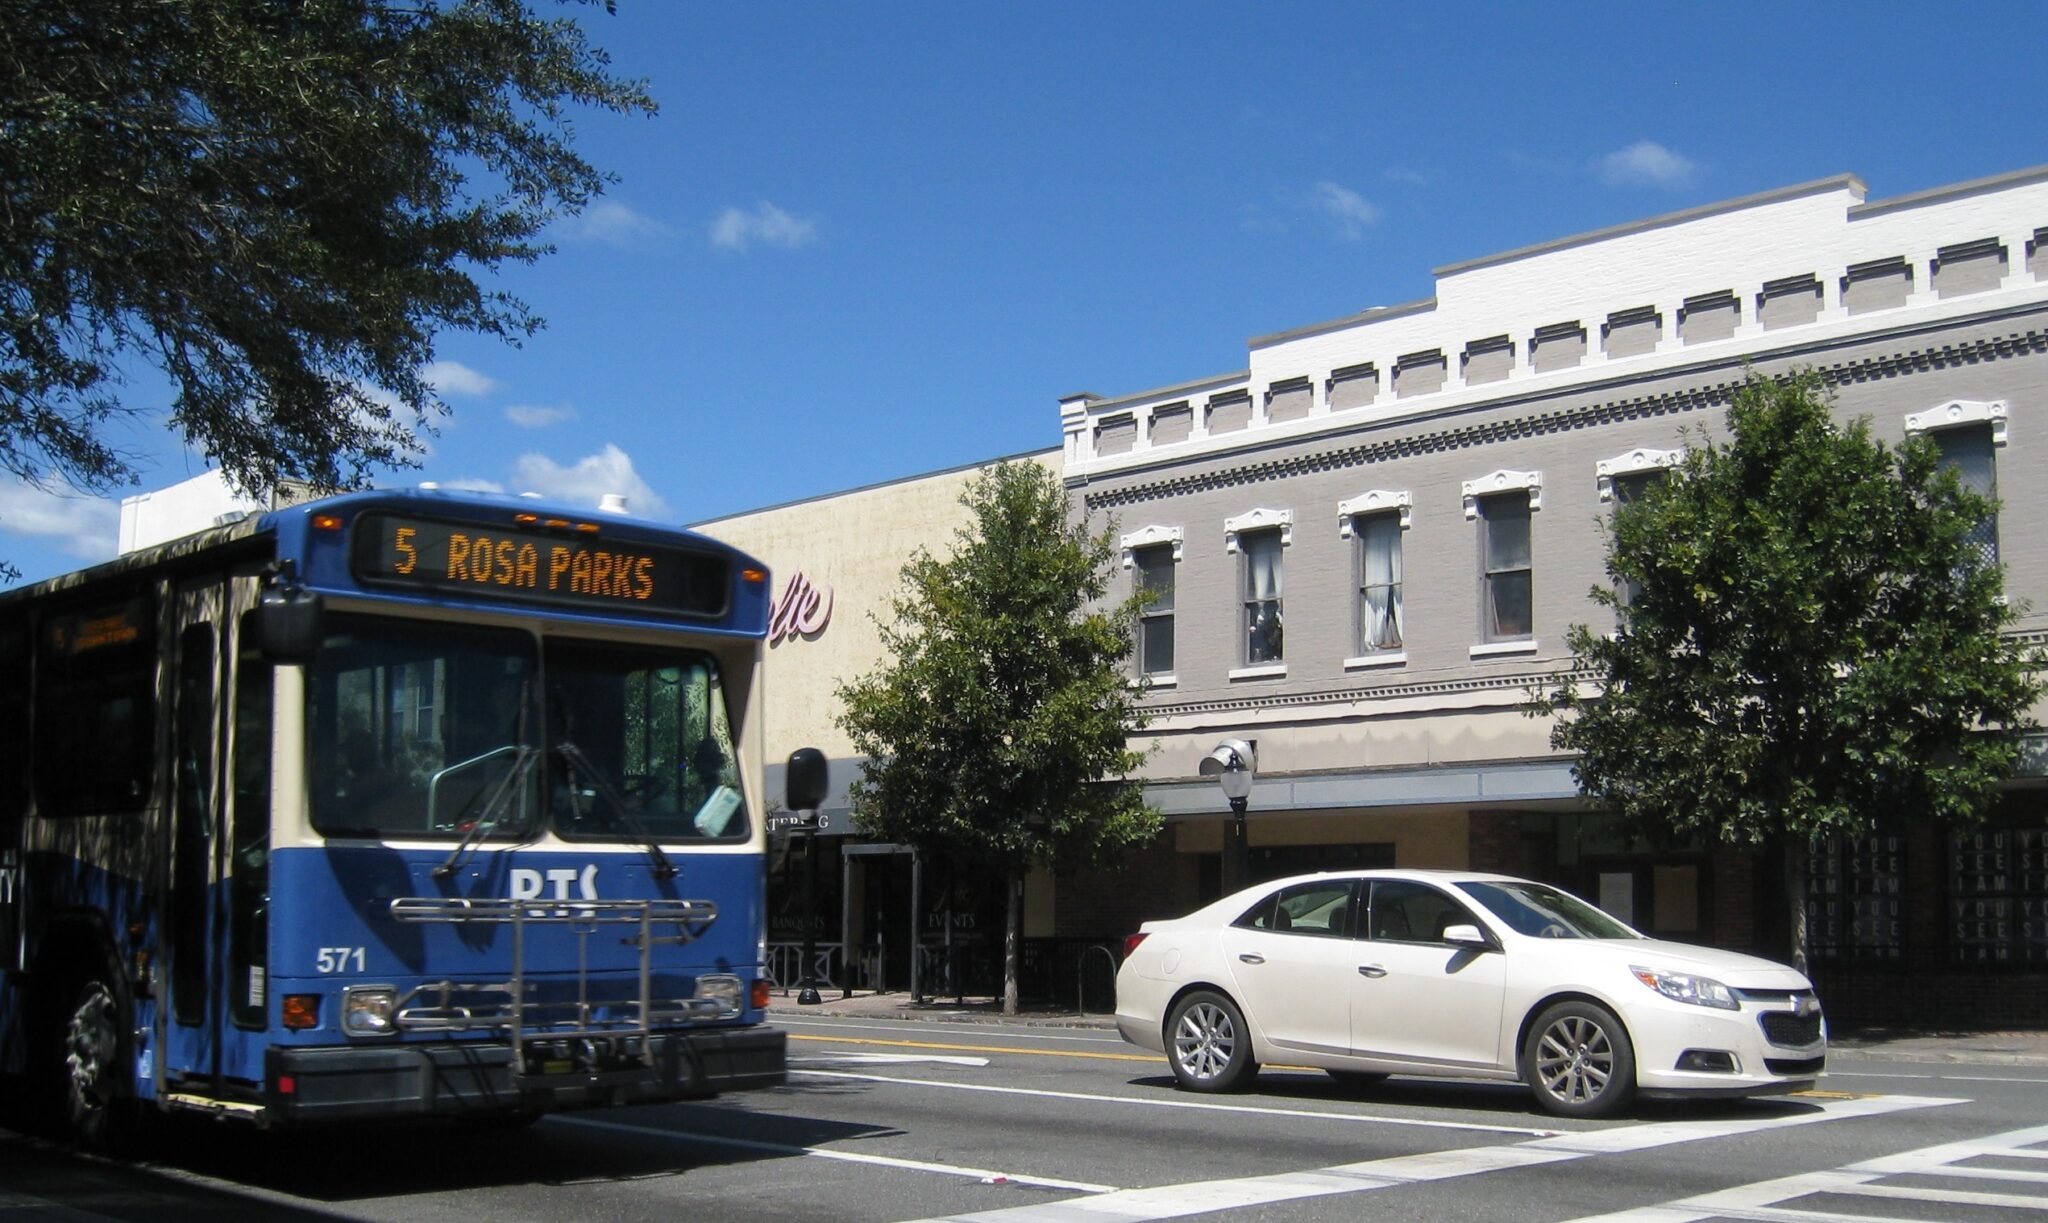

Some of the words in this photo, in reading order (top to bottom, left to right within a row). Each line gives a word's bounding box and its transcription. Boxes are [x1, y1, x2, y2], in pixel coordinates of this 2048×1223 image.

[395, 527, 416, 574] 5
[447, 533, 538, 588] ROSA
[548, 545, 654, 600] PARKS
[1955, 853, 2004, 871] SEE
[509, 864, 599, 918] RTS
[772, 915, 825, 931] BANQUTS
[929, 913, 976, 928] EVNTS
[316, 946, 366, 973] 571
